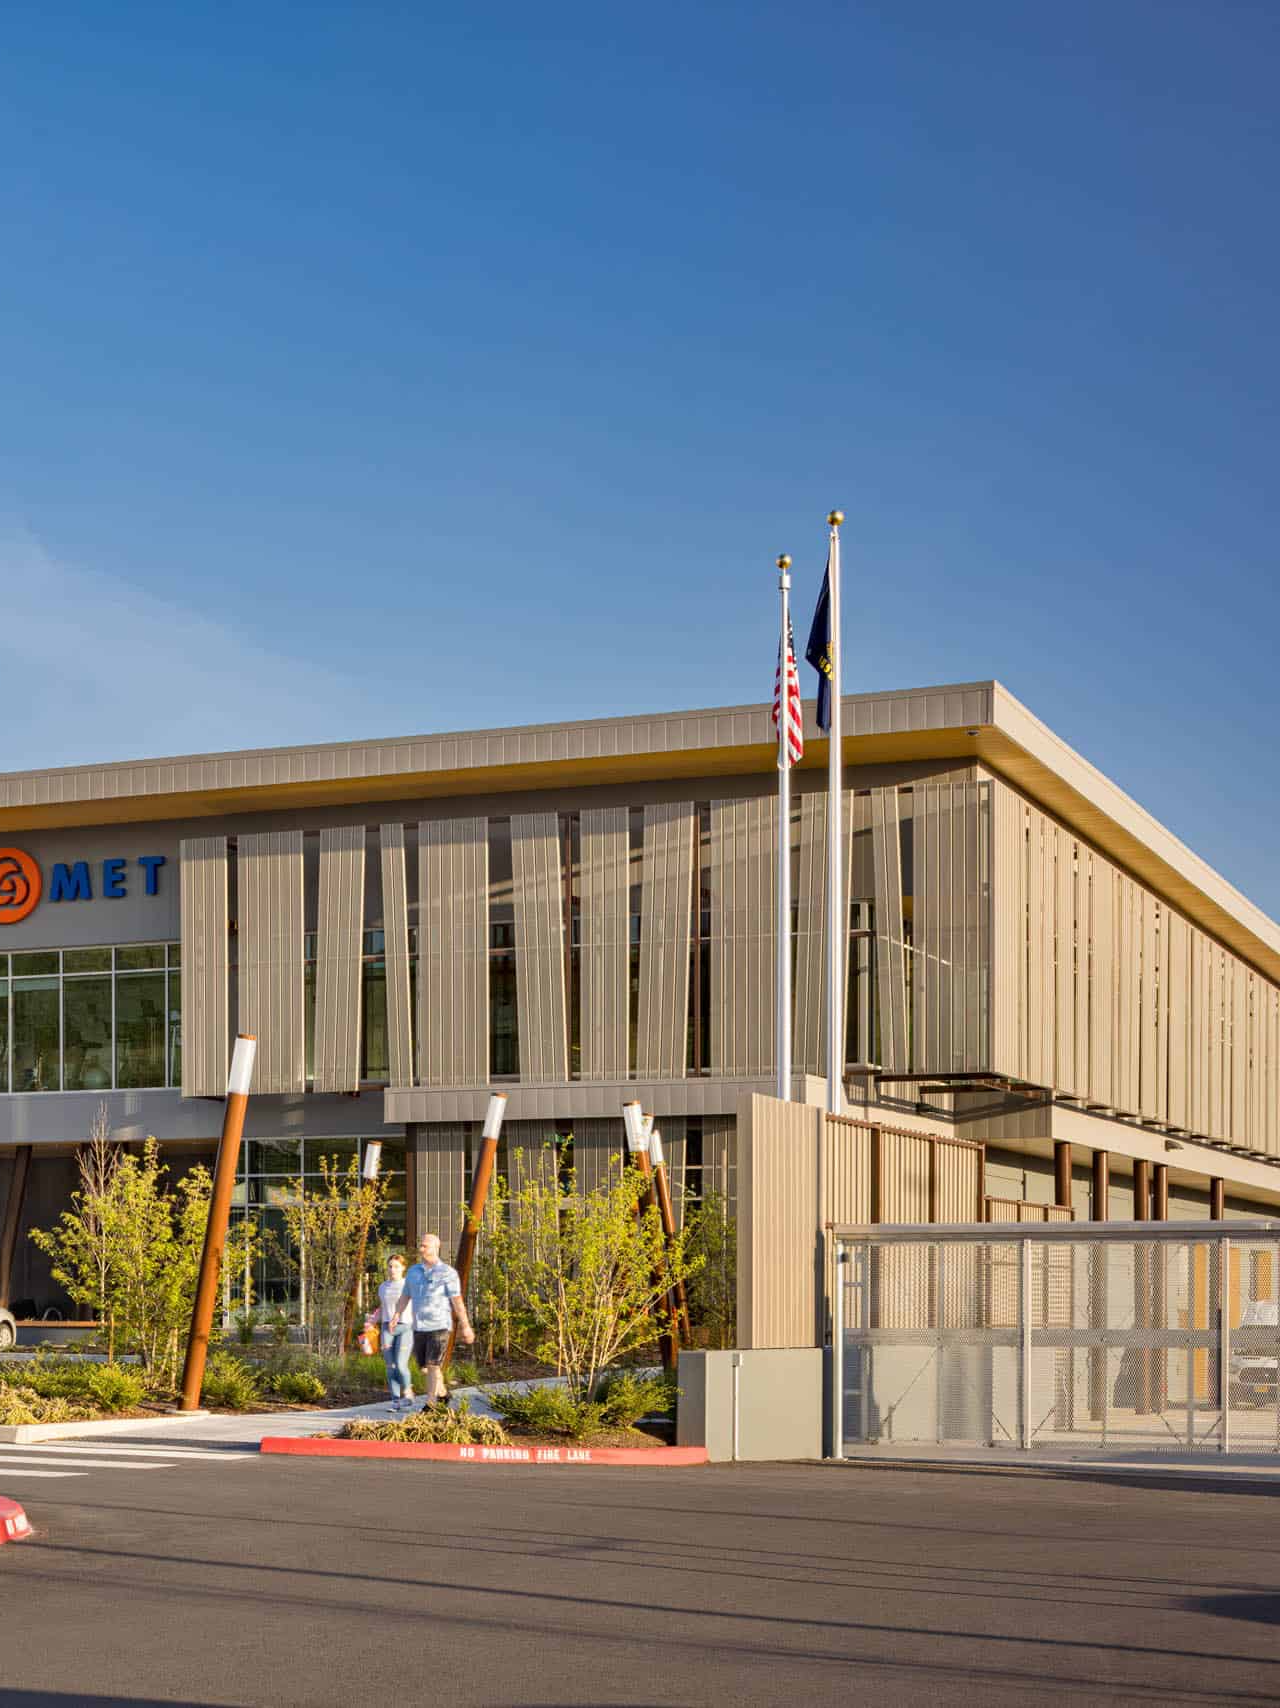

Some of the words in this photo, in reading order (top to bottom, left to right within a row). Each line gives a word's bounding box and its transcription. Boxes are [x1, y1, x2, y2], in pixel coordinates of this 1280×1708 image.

[49, 855, 167, 902] MET
[460, 1447, 475, 1458] NO
[482, 1447, 529, 1460] PARKING
[536, 1448, 560, 1461] FIRE
[567, 1449, 592, 1461] LANE
